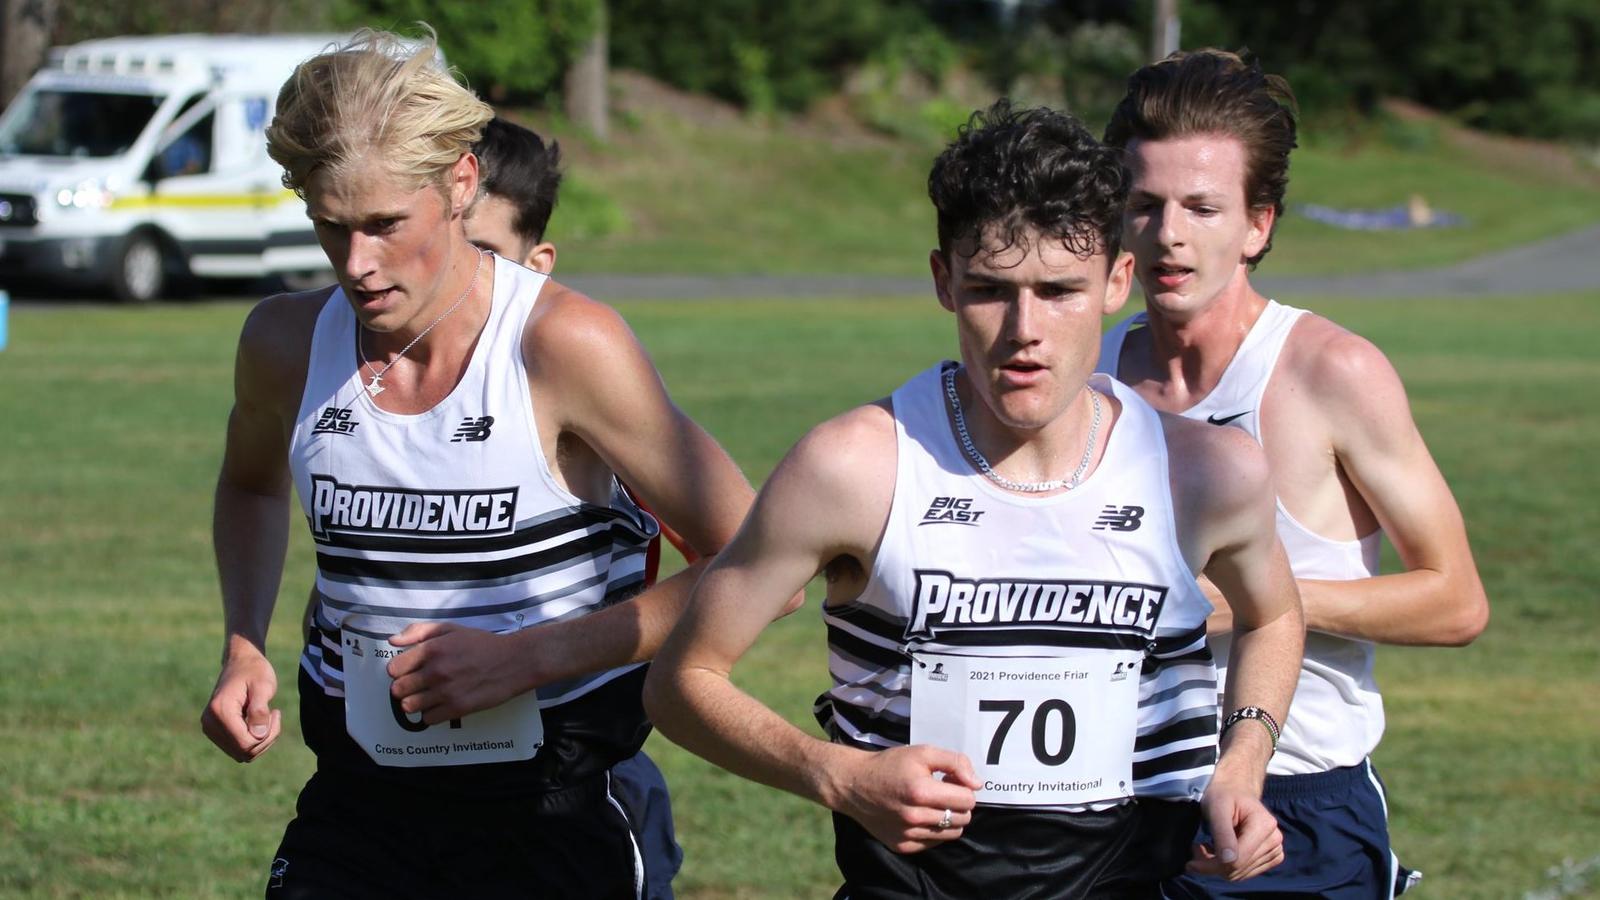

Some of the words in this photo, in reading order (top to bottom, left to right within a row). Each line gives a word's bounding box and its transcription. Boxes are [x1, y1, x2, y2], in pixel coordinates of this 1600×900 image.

[322, 407, 353, 420] BIG
[314, 419, 360, 433] EAST
[312, 478, 516, 536] PROVIDENCE
[930, 497, 974, 510] BIG
[922, 509, 985, 524] EAST
[908, 573, 1165, 634] PROVIDENCE
[374, 649, 394, 659] 2021
[969, 671, 995, 681] 2021
[999, 671, 1061, 681] Providence
[1064, 670, 1089, 681] Friar
[979, 698, 1076, 767] 70
[375, 743, 403, 755] Cross
[406, 745, 450, 755] Country
[453, 739, 514, 752] Invitational
[984, 780, 1034, 794] Country
[1038, 777, 1103, 791] Invitational
